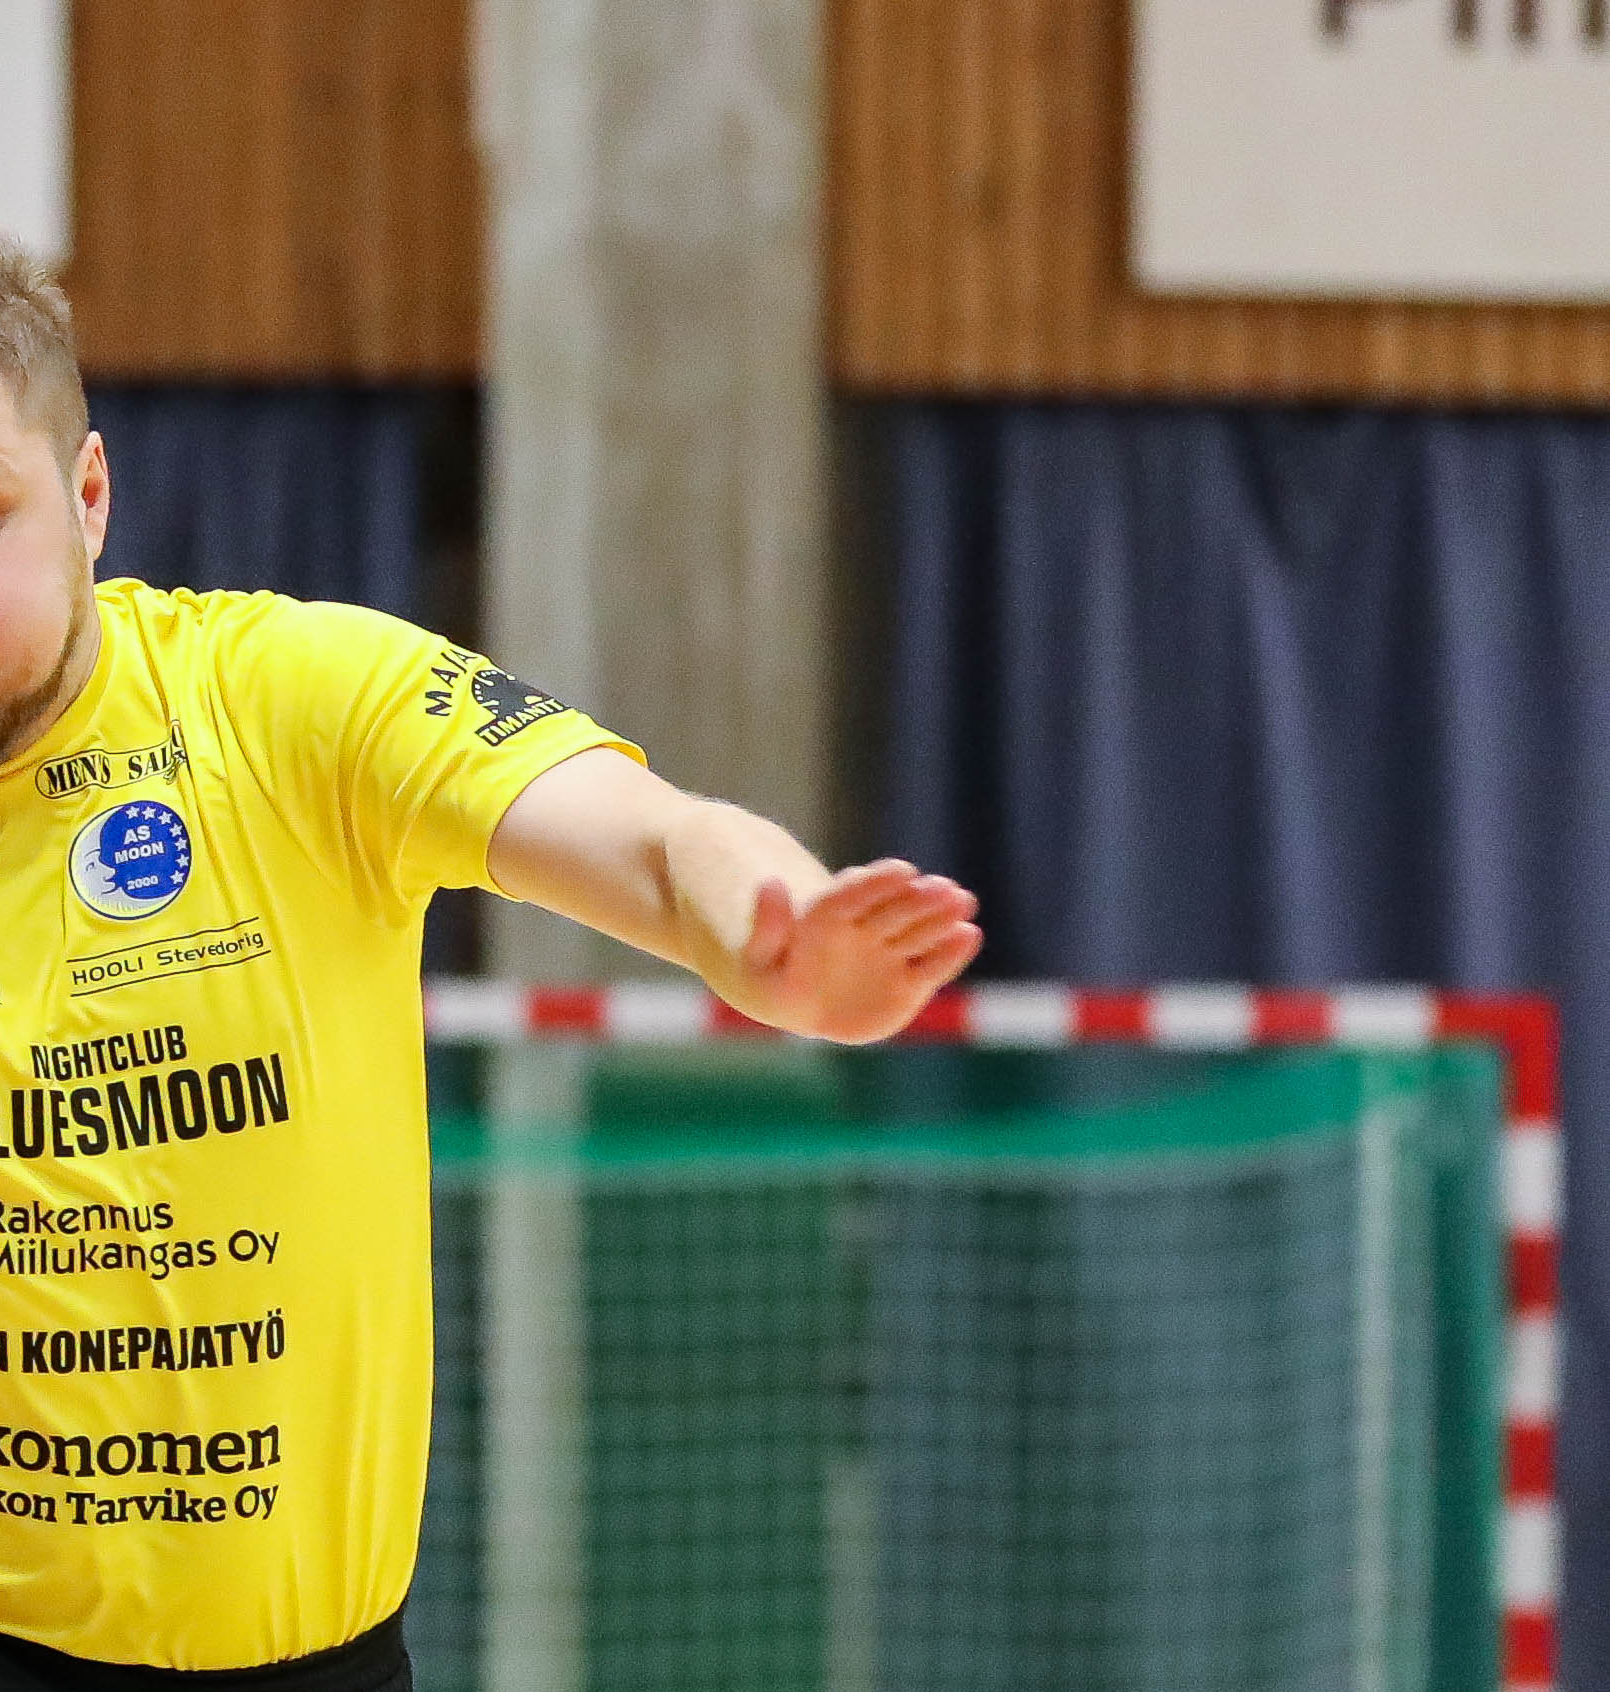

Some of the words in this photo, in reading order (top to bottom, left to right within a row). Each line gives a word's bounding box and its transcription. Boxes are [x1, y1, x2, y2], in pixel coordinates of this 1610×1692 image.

[426, 649, 478, 717] MAJA
[123, 824, 151, 845] AS
[114, 841, 165, 865] MOON
[127, 875, 159, 890] 2000
[72, 957, 144, 985] HOOLI
[228, 1230, 280, 1265] Oy
[21, 1307, 285, 1374] KONEPAJATYÖ
[66, 1488, 226, 1525] Tarvike
[233, 1484, 279, 1521] Oy
